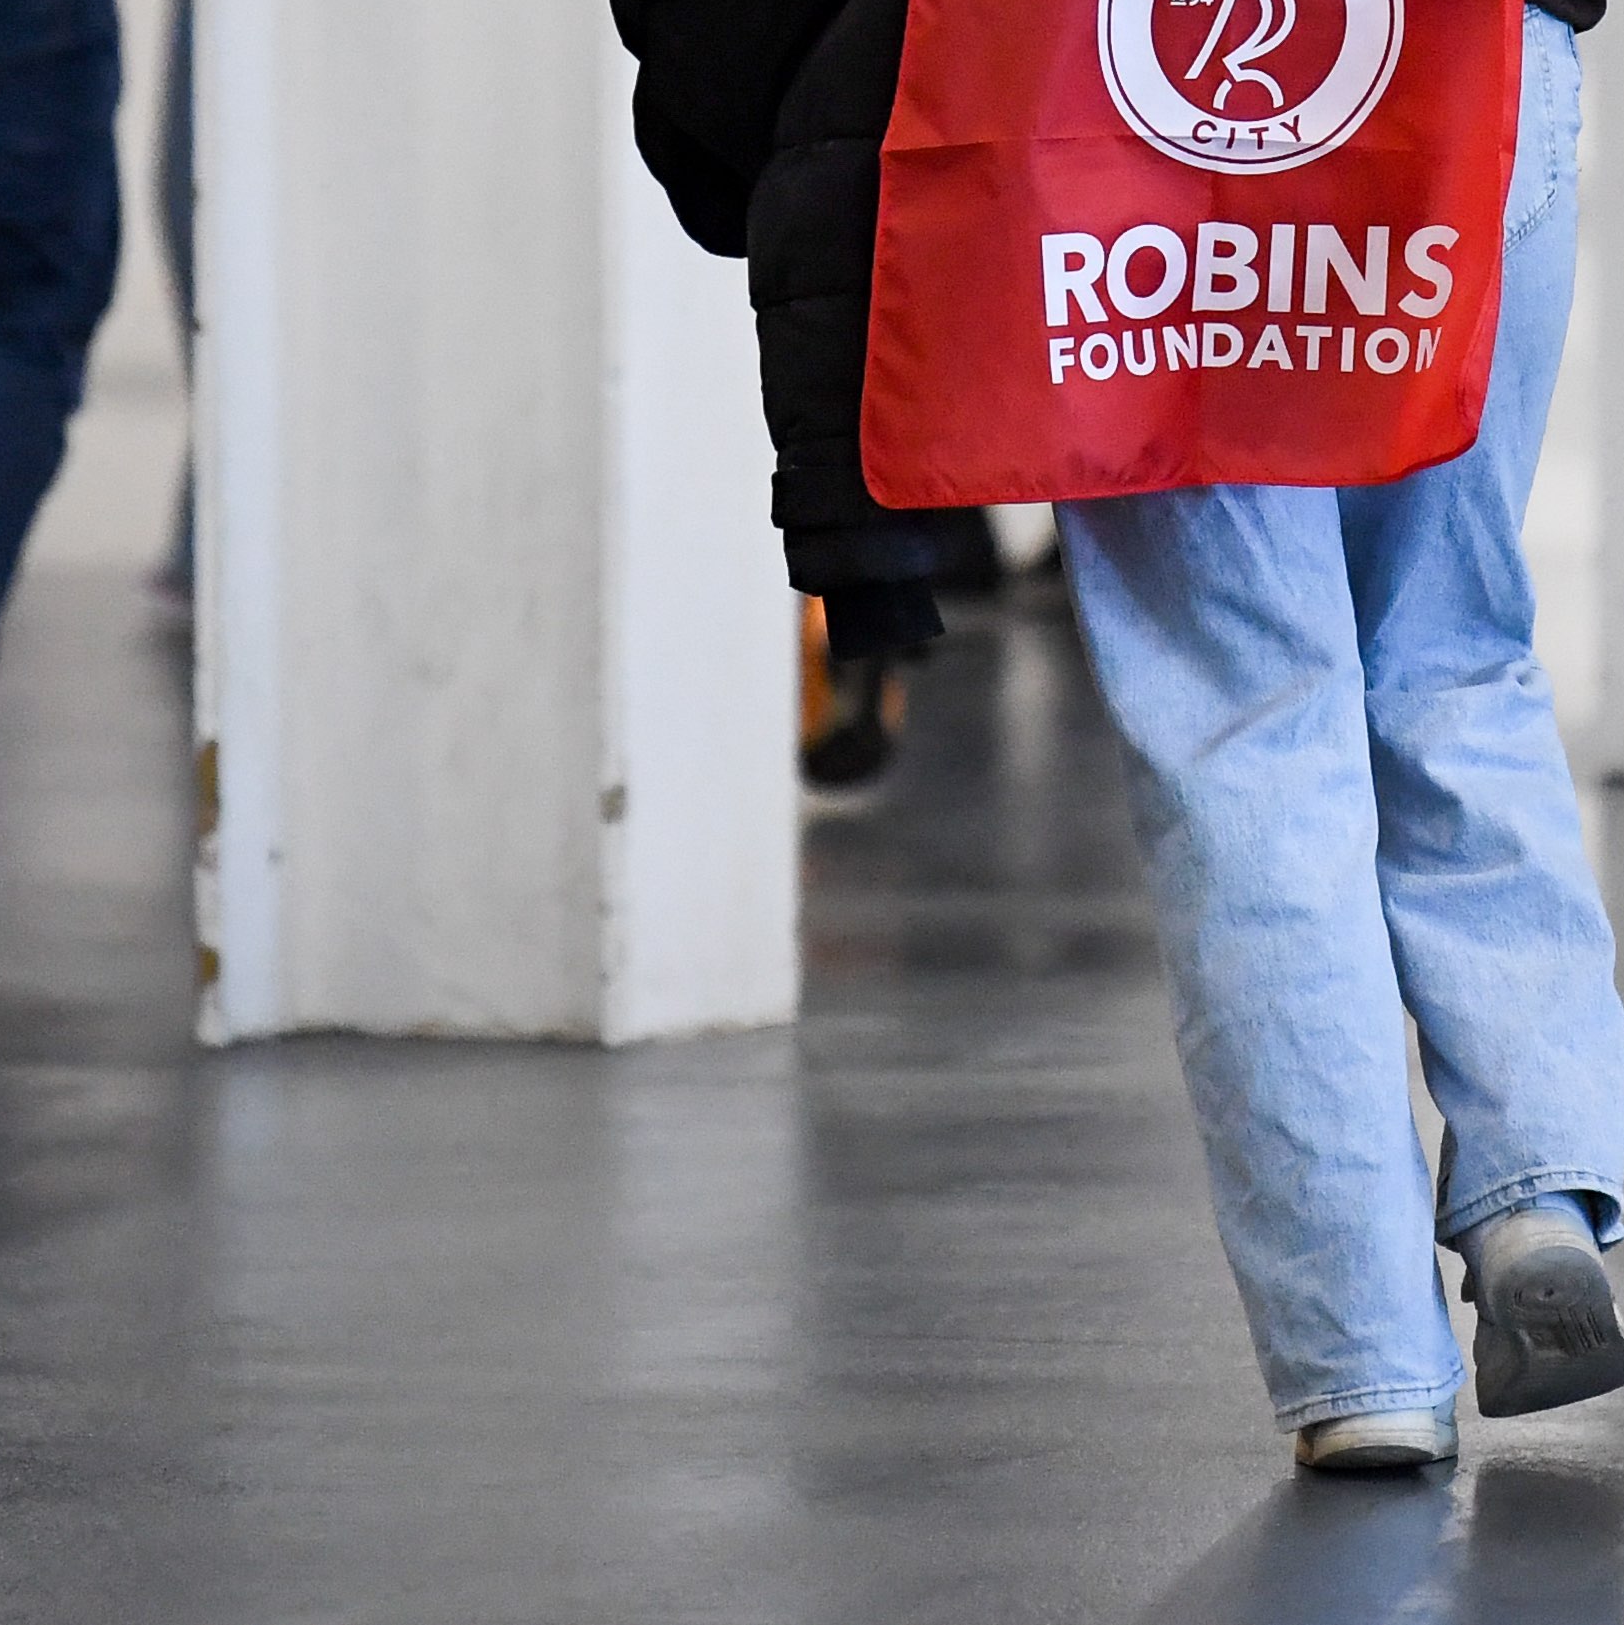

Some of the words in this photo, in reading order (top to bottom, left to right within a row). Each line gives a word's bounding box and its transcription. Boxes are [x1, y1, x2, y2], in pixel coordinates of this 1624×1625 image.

[1191, 114, 1302, 150] CITY
[1040, 220, 1461, 328] ROBINS
[1048, 321, 1443, 385] FOUNDATION
